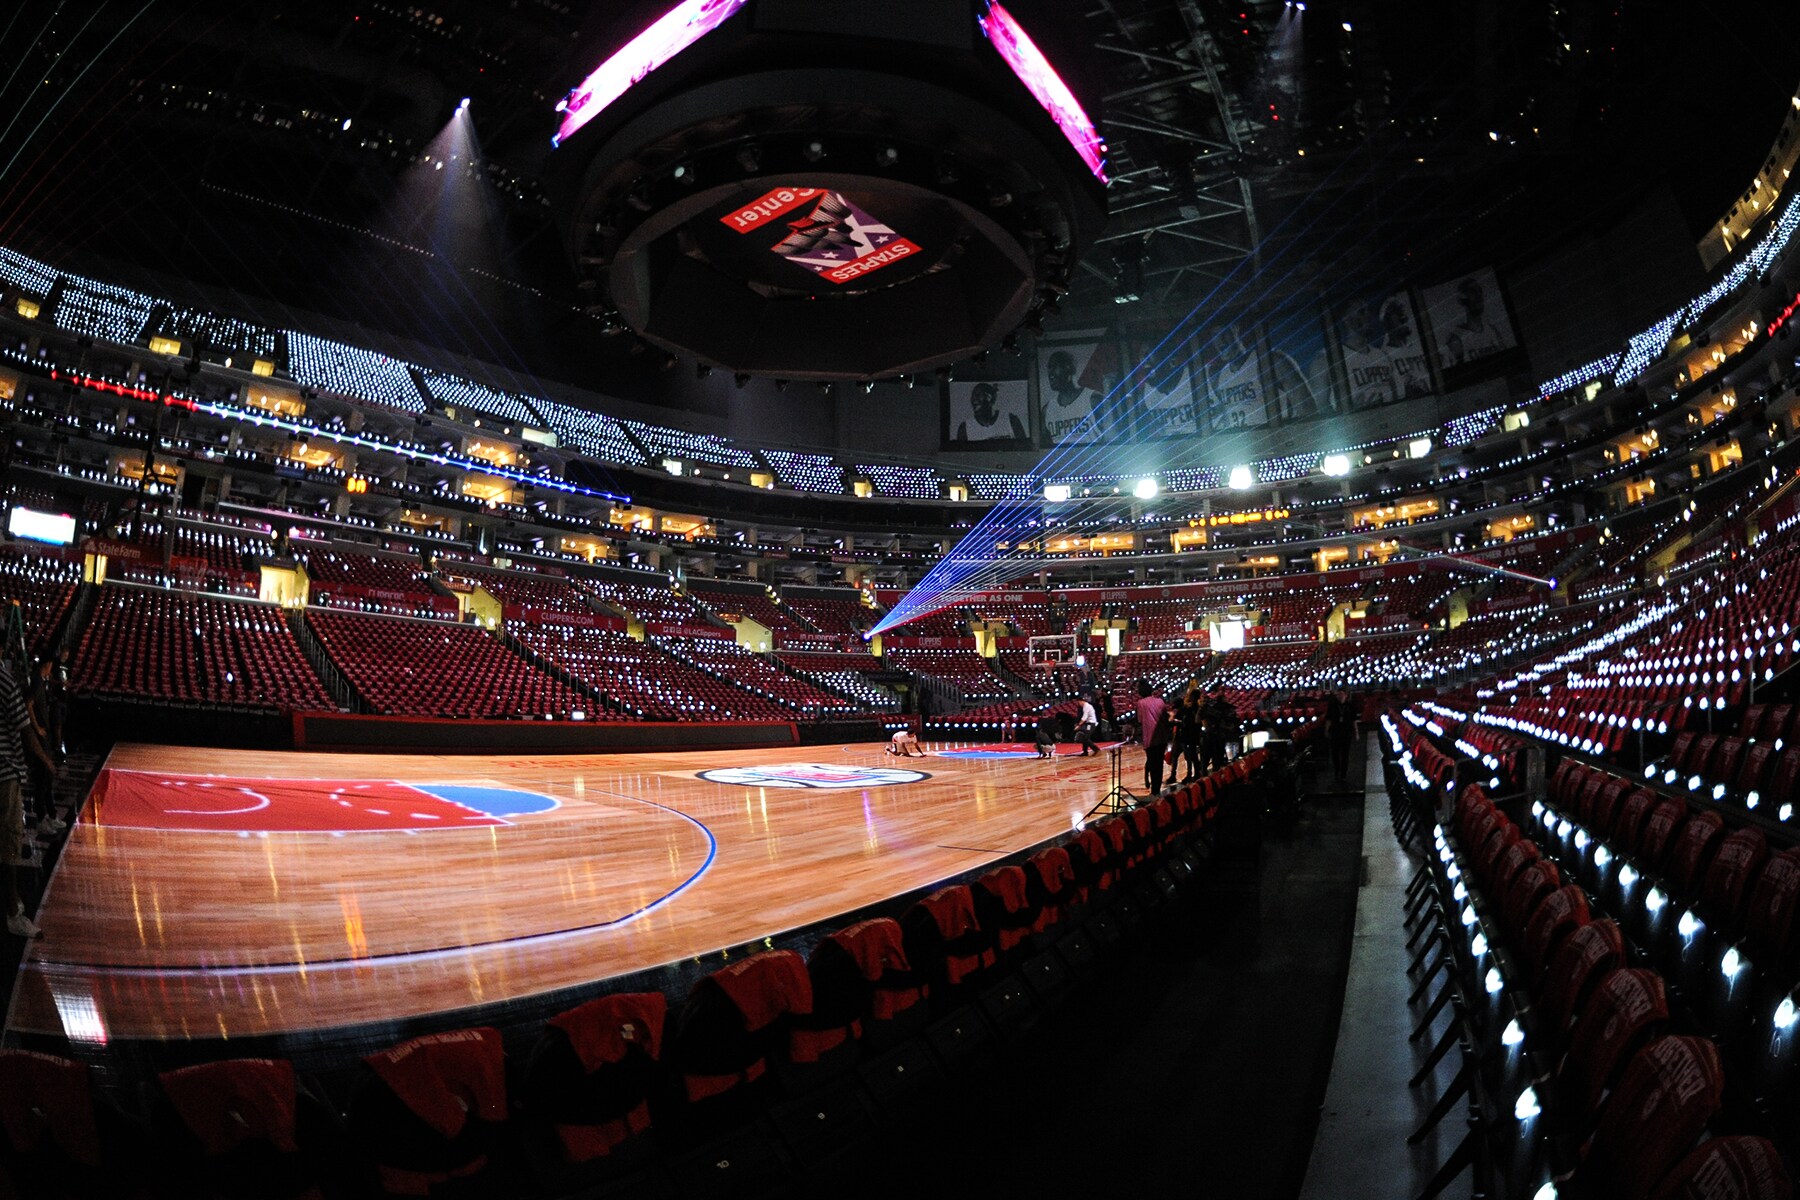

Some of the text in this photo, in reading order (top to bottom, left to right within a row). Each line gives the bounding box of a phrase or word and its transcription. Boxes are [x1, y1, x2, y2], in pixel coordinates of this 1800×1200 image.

[832, 244, 911, 281] STAPLES
[509, 512, 535, 523] TOYOTA
[1204, 581, 1284, 594] TOGETHER AS ONE
[1003, 594, 1023, 602] ONE
[541, 612, 594, 625] CLIPPERS.COM
[683, 628, 721, 637] @LAClippers
[919, 637, 942, 646] CLIPPERS
